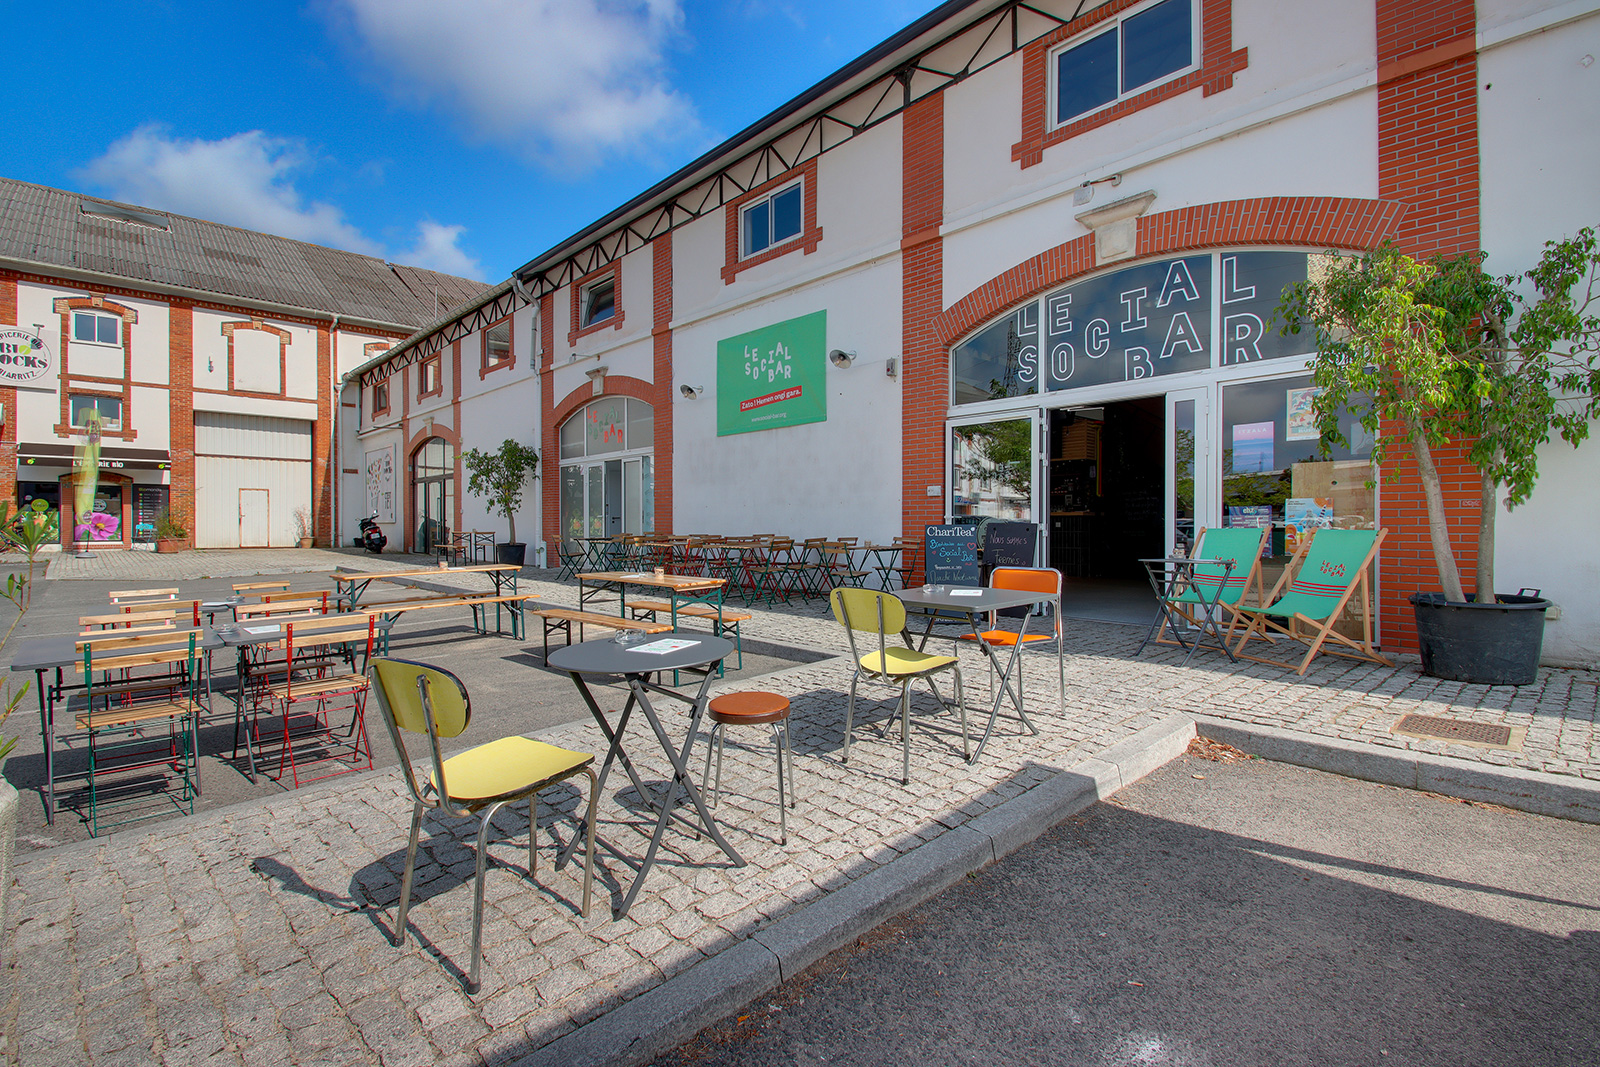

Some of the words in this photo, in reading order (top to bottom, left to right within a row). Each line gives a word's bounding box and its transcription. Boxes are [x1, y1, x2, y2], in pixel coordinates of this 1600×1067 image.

[1017, 293, 1073, 337] LE
[0, 331, 31, 341] PICERIE
[744, 345, 758, 362] LE
[1124, 311, 1264, 382] BAR
[0, 354, 48, 368] OCKS
[744, 341, 791, 380] SOCIAL
[767, 360, 791, 383] BAR
[586, 406, 598, 423] LE
[603, 423, 624, 443] BAR
[926, 526, 974, 537] ChariTea
[989, 530, 1004, 545] Nous
[938, 547, 961, 558] Social
